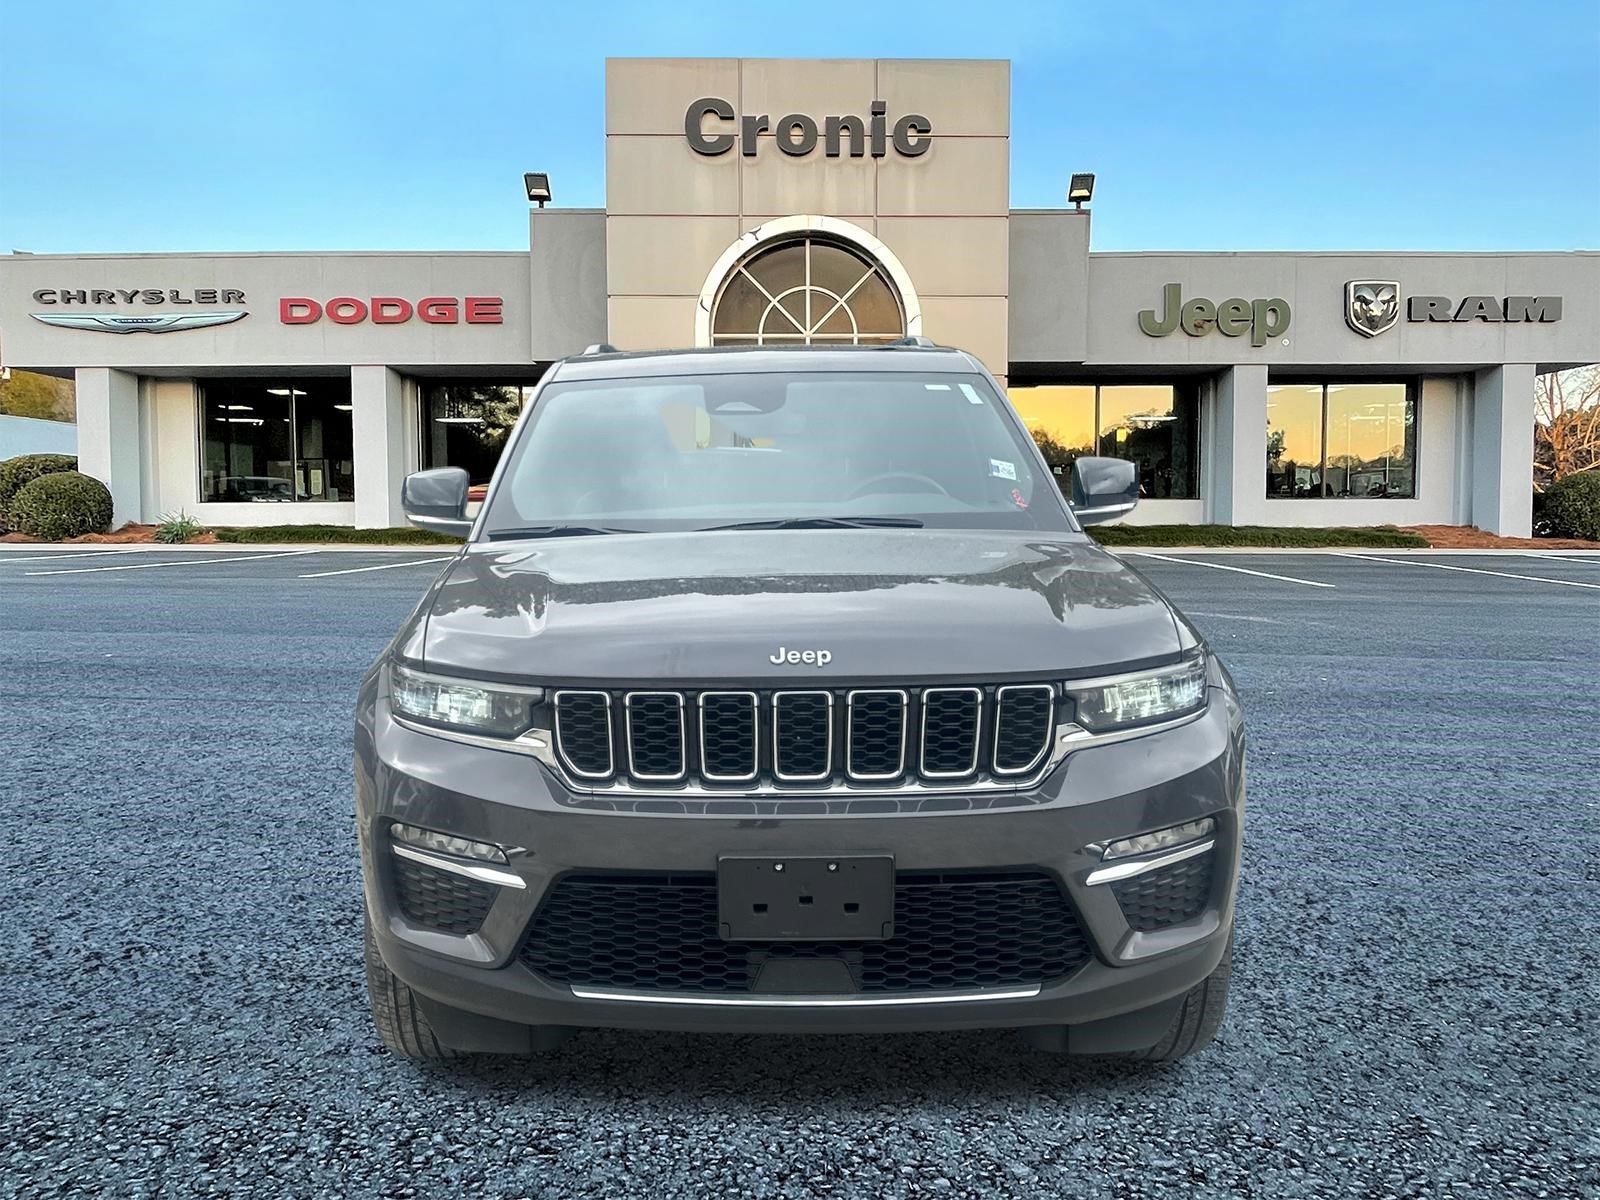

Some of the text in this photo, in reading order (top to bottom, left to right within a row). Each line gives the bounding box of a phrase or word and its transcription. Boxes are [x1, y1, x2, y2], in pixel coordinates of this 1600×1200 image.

[684, 97, 932, 157] Cronic
[32, 288, 246, 304] CHRYSLER
[1407, 296, 1563, 322] RAM
[279, 297, 504, 324] DODGE
[1138, 283, 1292, 347] Jeep
[769, 647, 832, 668] Jeep
